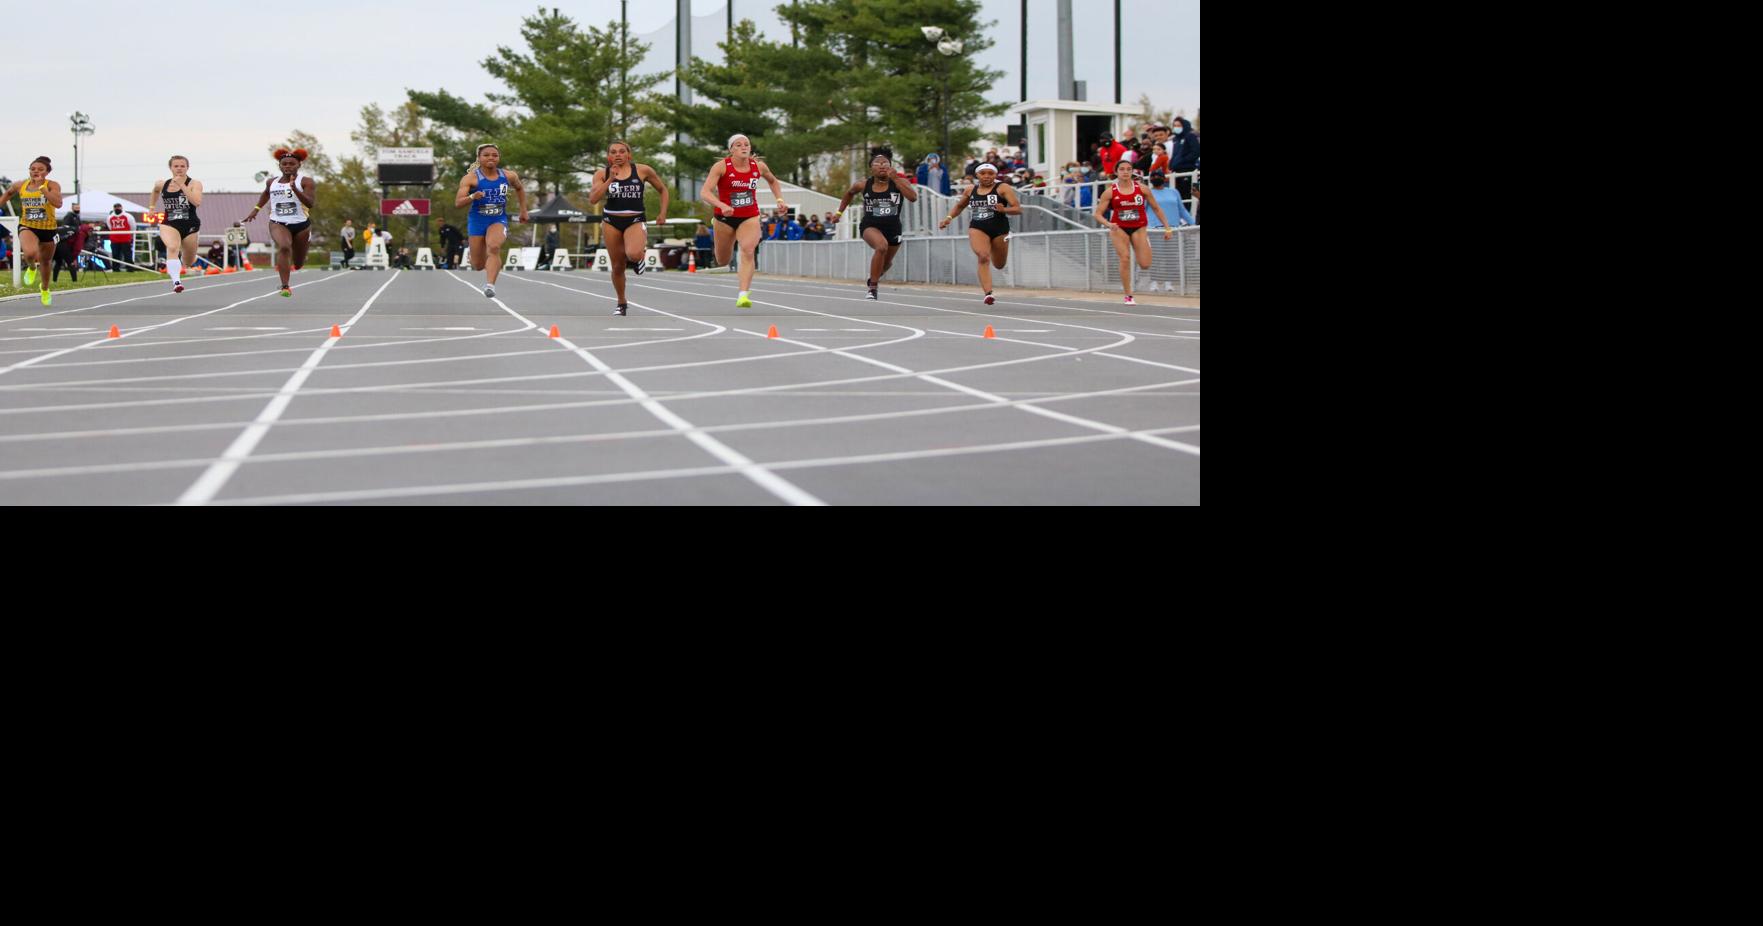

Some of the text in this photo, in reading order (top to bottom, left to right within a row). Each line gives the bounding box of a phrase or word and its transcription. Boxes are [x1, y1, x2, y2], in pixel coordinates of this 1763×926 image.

[610, 183, 617, 192] 5
[751, 180, 757, 189] 6
[286, 189, 293, 198] 3
[502, 185, 507, 194] 4
[181, 196, 187, 204] 2
[734, 197, 751, 206] 388
[893, 194, 899, 204] 7
[990, 195, 996, 204] 8
[1136, 196, 1142, 205] 9
[228, 232, 246, 241] 0 3
[420, 254, 429, 264] 4
[510, 254, 518, 265] 6
[557, 255, 566, 265] 7
[598, 254, 608, 265] 8
[648, 255, 658, 266] 9
